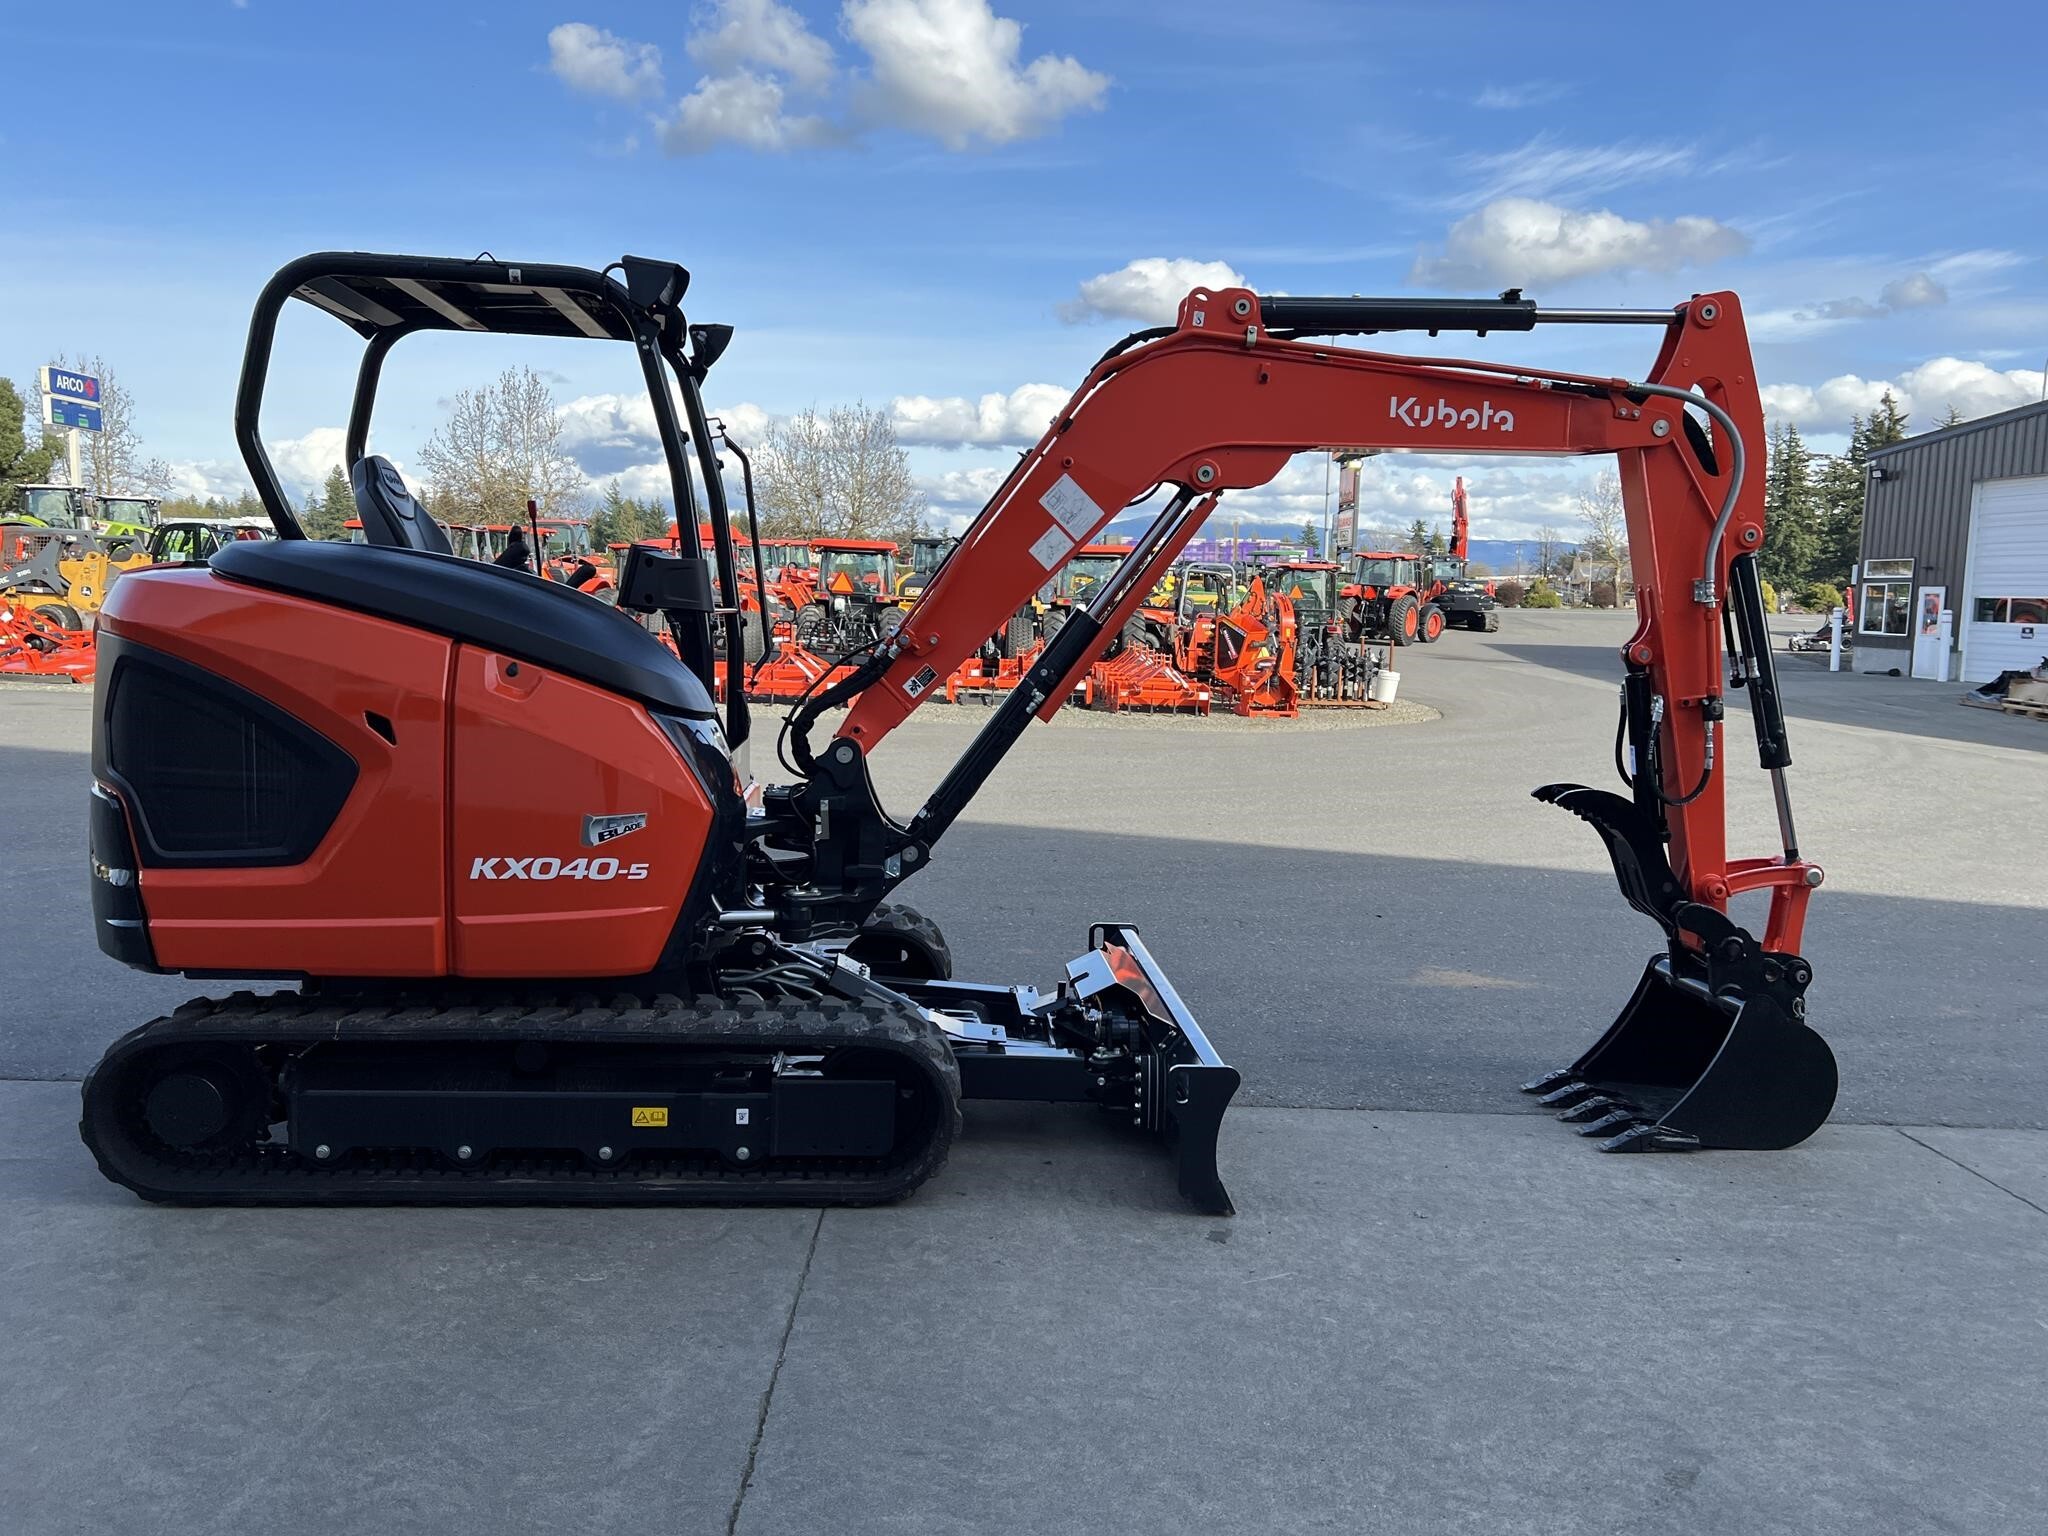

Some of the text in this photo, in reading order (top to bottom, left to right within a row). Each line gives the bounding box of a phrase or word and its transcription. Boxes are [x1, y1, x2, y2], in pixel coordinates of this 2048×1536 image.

[56, 374, 84, 393] ARCO
[1389, 396, 1514, 432] Kubota
[598, 821, 643, 843] BLADE
[469, 857, 650, 881] KX040-5
